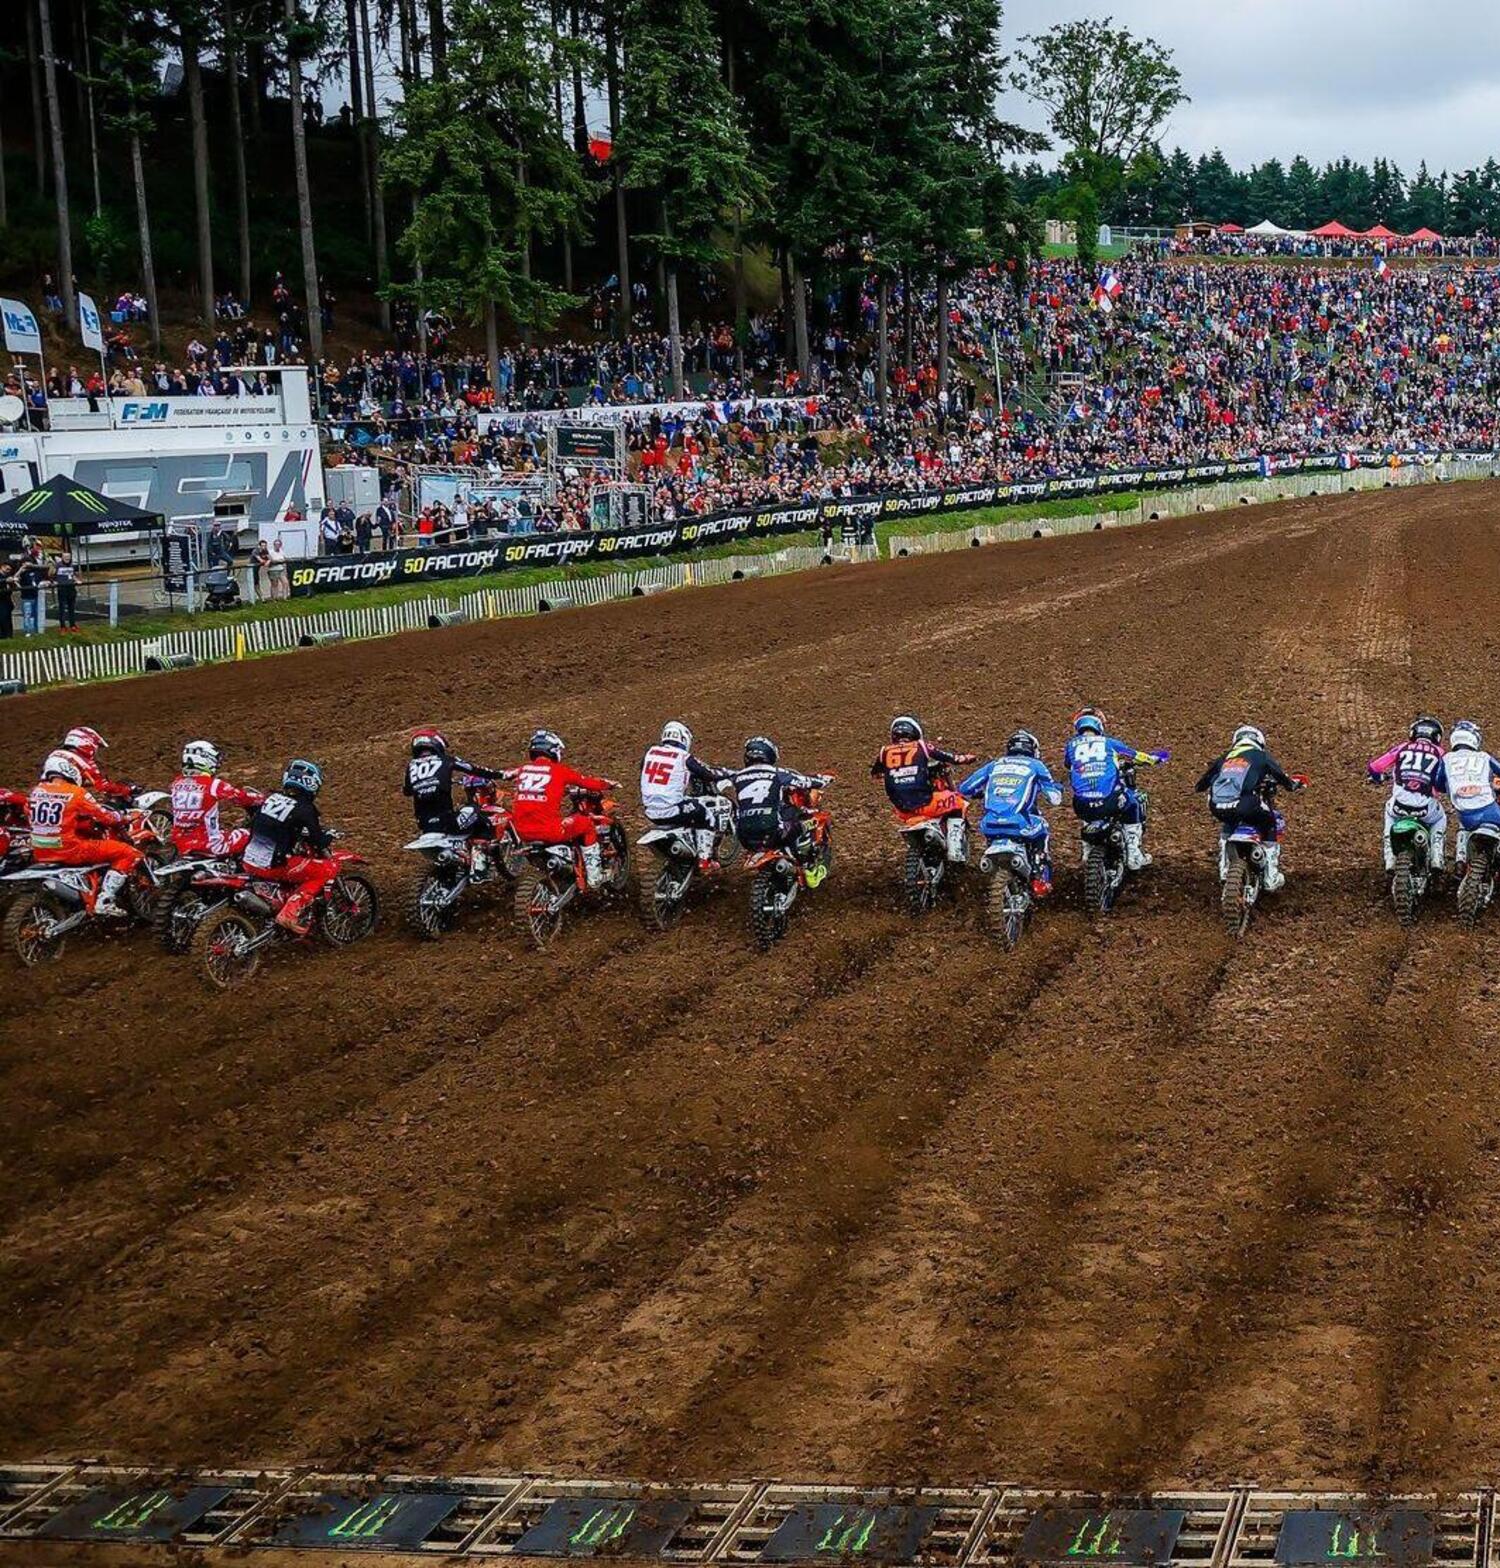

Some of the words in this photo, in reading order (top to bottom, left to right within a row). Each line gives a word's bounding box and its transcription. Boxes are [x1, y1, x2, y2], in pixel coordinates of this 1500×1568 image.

[943, 494, 956, 506] 50
[956, 488, 996, 504] FACTORY
[998, 486, 1009, 498] 50
[1009, 482, 1047, 497] FACTORY
[756, 514, 770, 527] 50
[770, 508, 820, 524] FACTORY
[823, 505, 837, 518] 50
[837, 500, 883, 517] FACTORY
[681, 525, 698, 540] 50
[697, 515, 752, 537] FACTORY
[505, 545, 525, 561] 50
[524, 539, 595, 559] FACTORY
[599, 537, 616, 552] 50
[615, 529, 677, 550] FACTORY
[404, 557, 425, 574] 50
[424, 549, 499, 571] FACTORY
[292, 568, 315, 586] 50
[314, 561, 397, 583] FACTORY
[885, 746, 918, 769] 67
[1074, 741, 1107, 763] 44
[1400, 750, 1438, 774] 217
[410, 760, 442, 784] 207
[519, 771, 552, 792] 32
[644, 760, 675, 786] 45
[738, 779, 774, 804] 4
